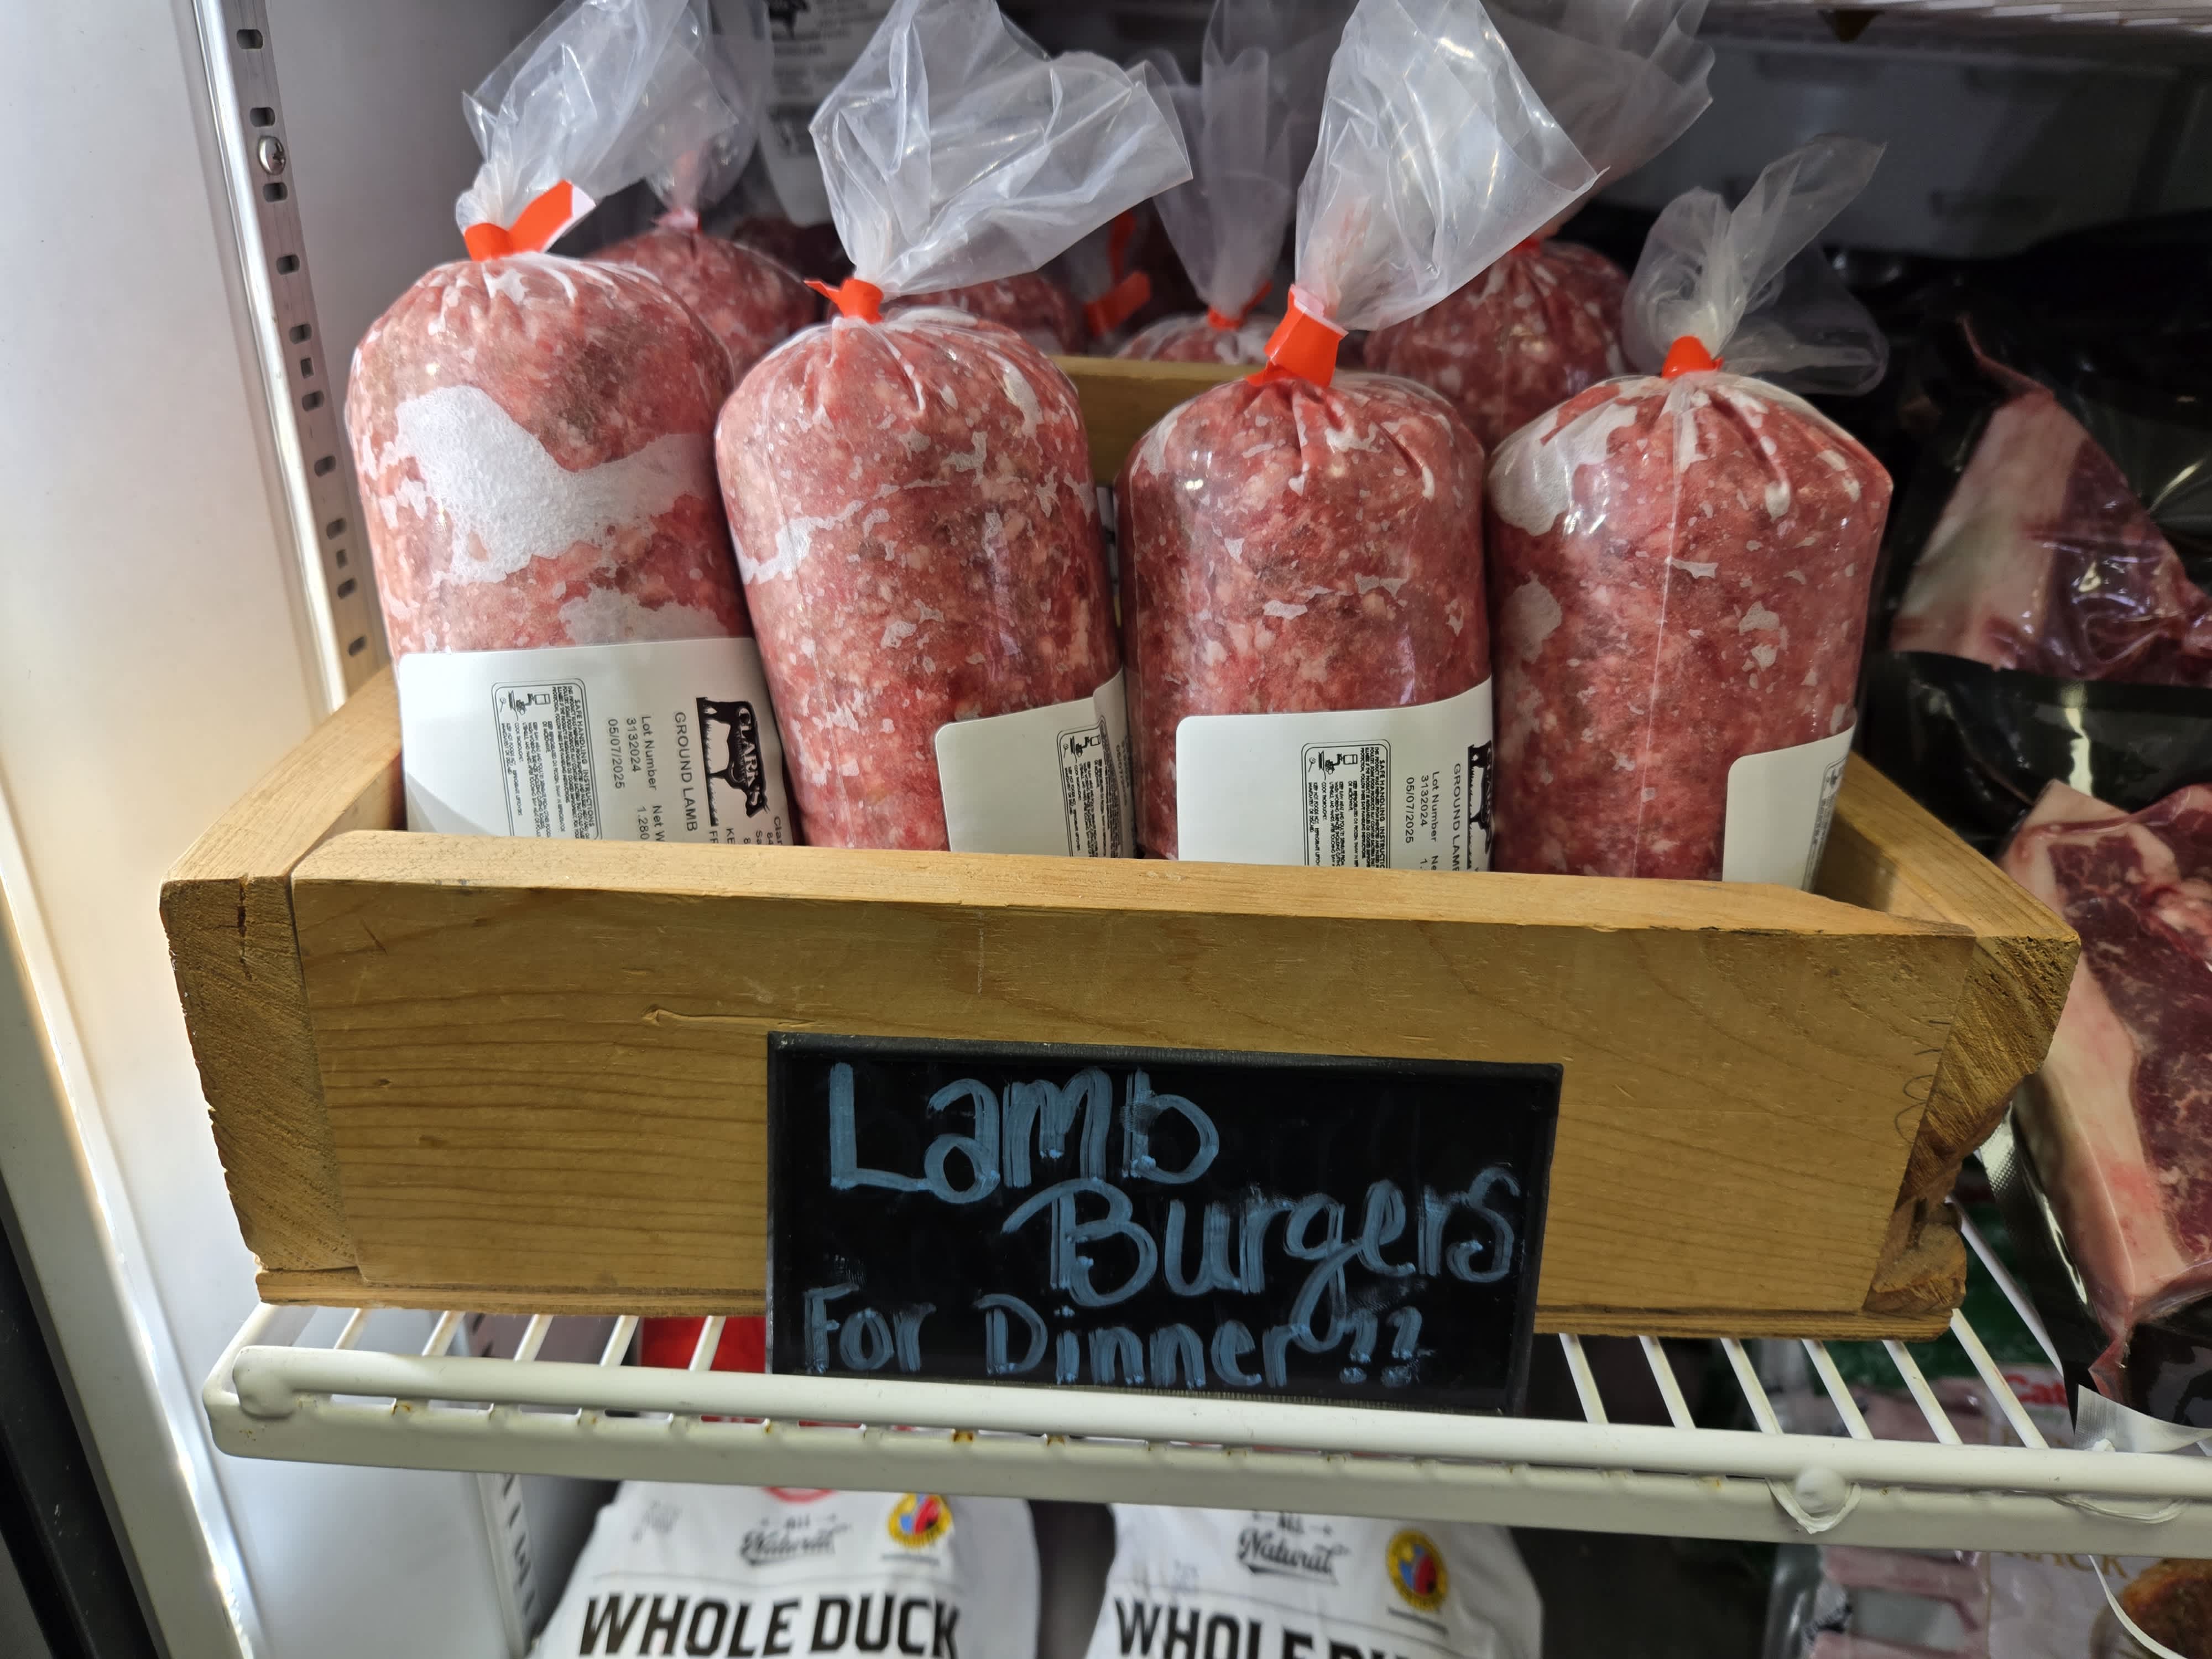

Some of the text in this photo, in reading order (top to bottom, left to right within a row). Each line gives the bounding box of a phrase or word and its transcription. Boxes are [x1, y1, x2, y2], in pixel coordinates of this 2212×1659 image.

[575, 699, 594, 827] SAFE HANDLING INSTRUCTIONS
[608, 718, 624, 789] 05/07/2025
[627, 718, 641, 773] 3132024
[641, 716, 657, 791] Lot Number
[675, 712, 698, 832] GROUND LAMB
[653, 805, 664, 827] Net
[1405, 776, 1415, 844] 05/07/2025
[1421, 775, 1429, 827] 3132024
[1431, 794, 1439, 842] Number
[829, 1061, 1220, 1204] Lamb
[1002, 1166, 1521, 1354] Burgers
[804, 1282, 935, 1374] For
[578, 1593, 960, 1659] WHOLE DUCK
